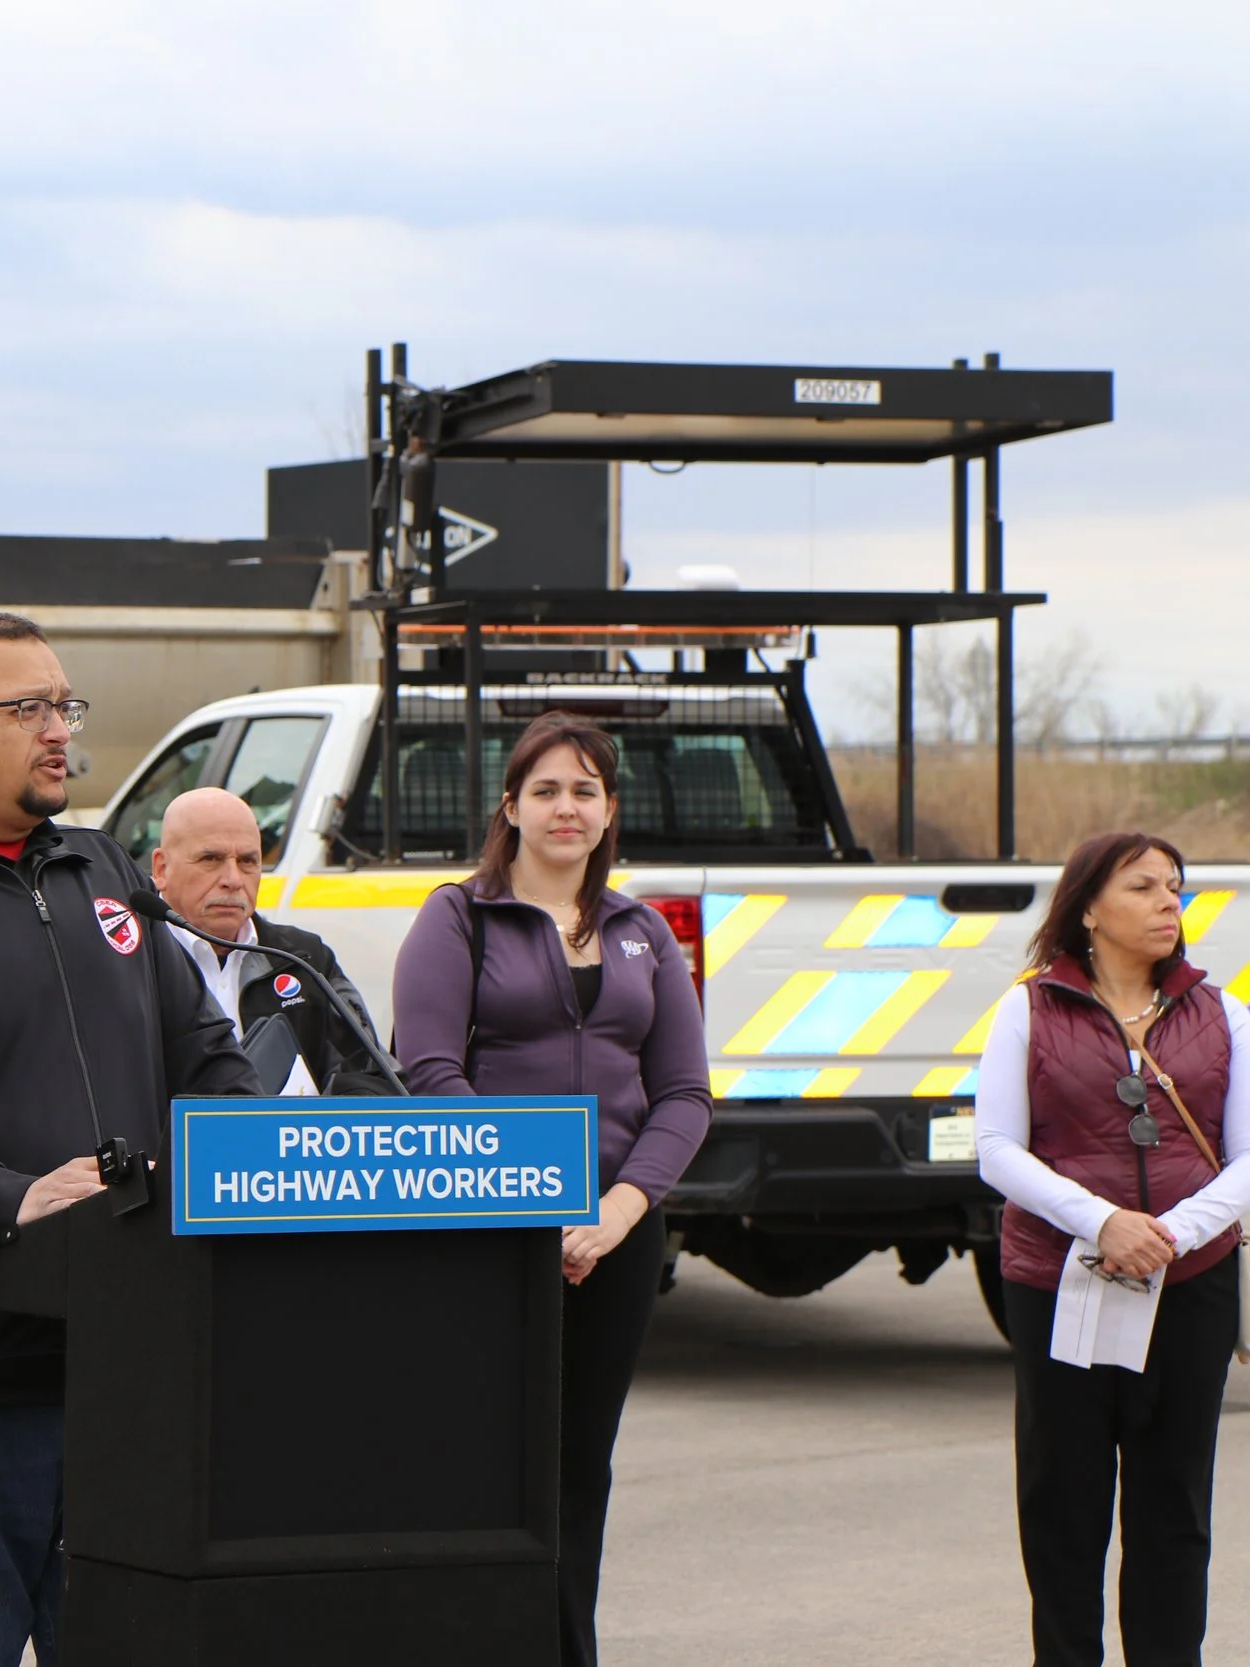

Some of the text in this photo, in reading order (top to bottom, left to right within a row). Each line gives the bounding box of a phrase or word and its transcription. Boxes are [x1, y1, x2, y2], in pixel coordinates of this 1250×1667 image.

[800, 381, 871, 402] 209057
[279, 1124, 499, 1158] PROTECTING
[214, 1166, 563, 1203] HIGHWAY WORKERS
